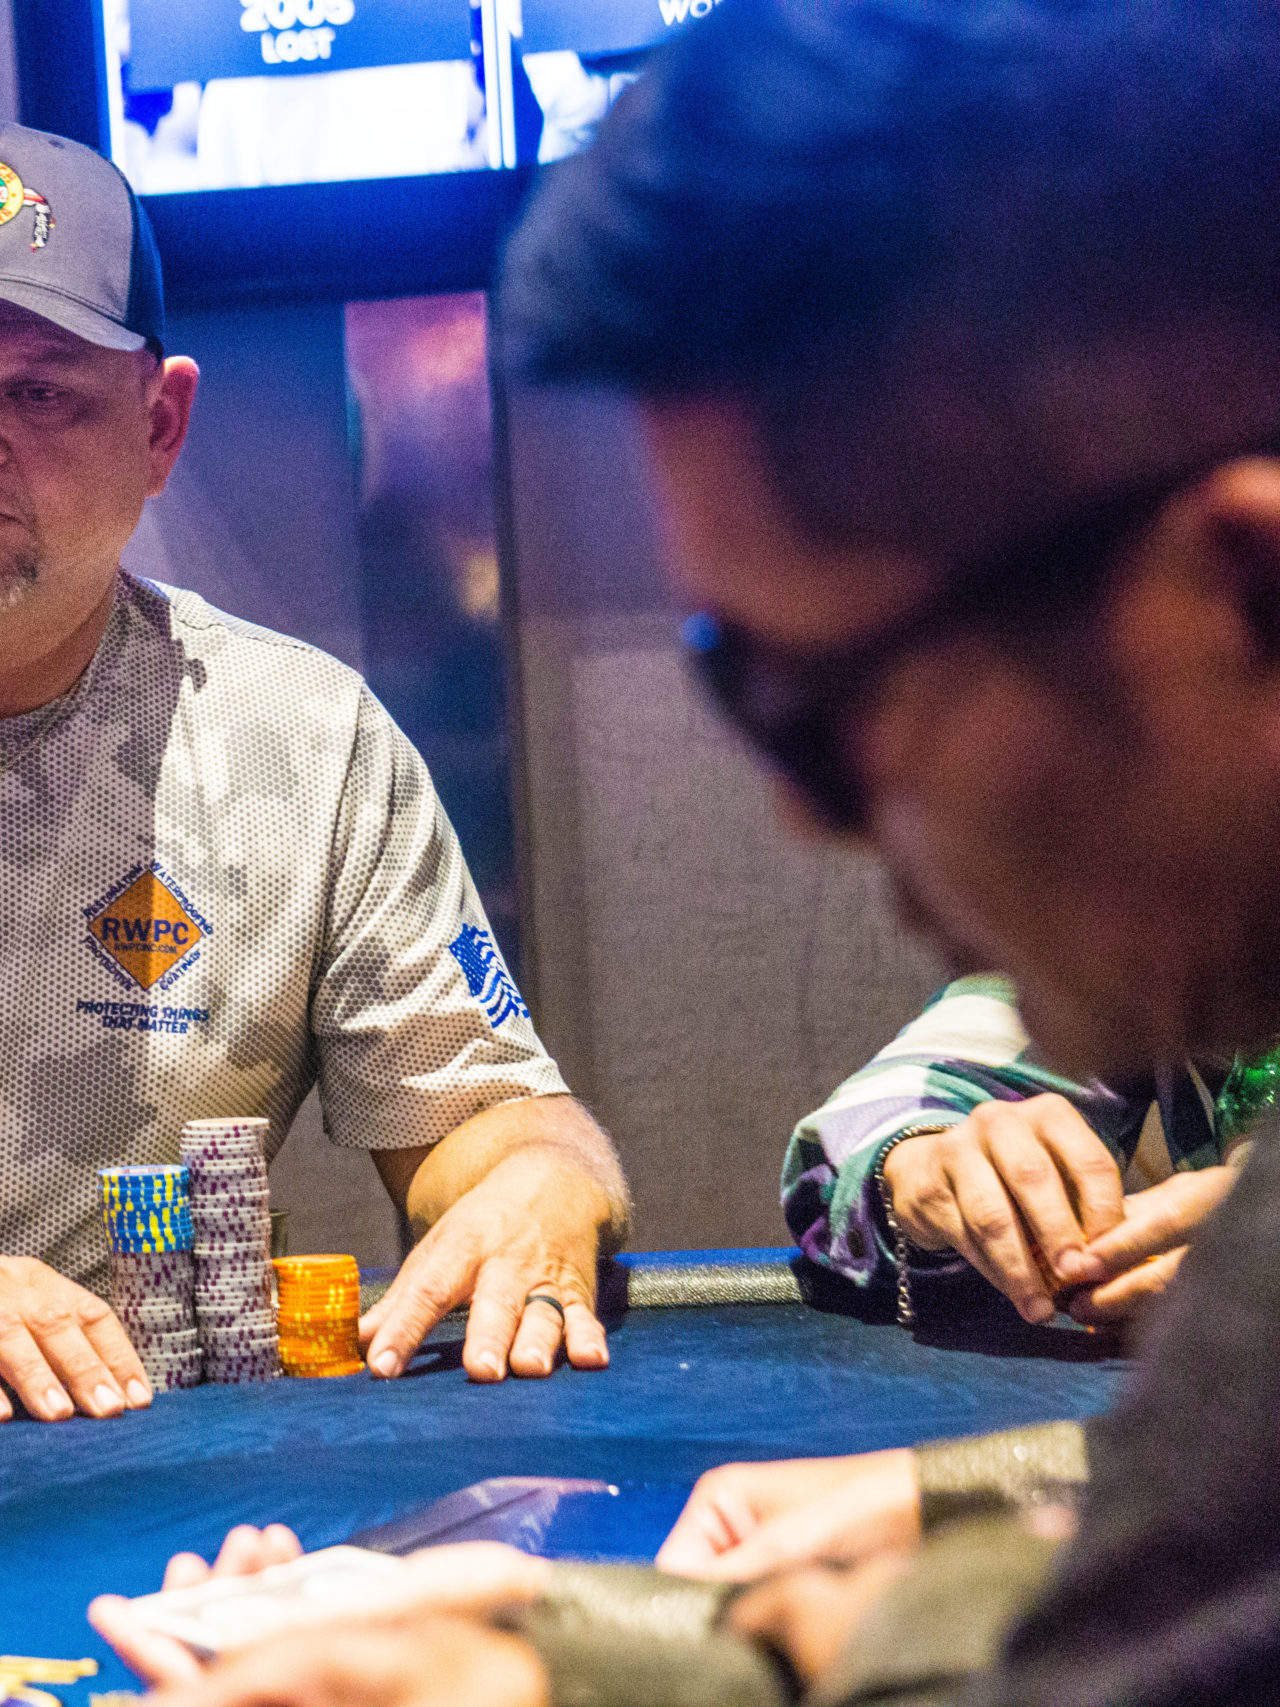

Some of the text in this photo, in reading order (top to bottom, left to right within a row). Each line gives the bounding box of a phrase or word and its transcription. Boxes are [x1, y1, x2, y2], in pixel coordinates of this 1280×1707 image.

[658, 0, 720, 26] WO
[261, 27, 336, 64] LOST
[83, 860, 143, 919] RESTORATION
[151, 861, 214, 936] WATERPROOFING
[101, 917, 190, 945] RWPC
[81, 935, 134, 992] PROTECTIVE
[159, 950, 202, 991] COATINGS
[76, 1000, 210, 1022] PROTECTING THINGS
[102, 1015, 188, 1034] THAT MATTER
